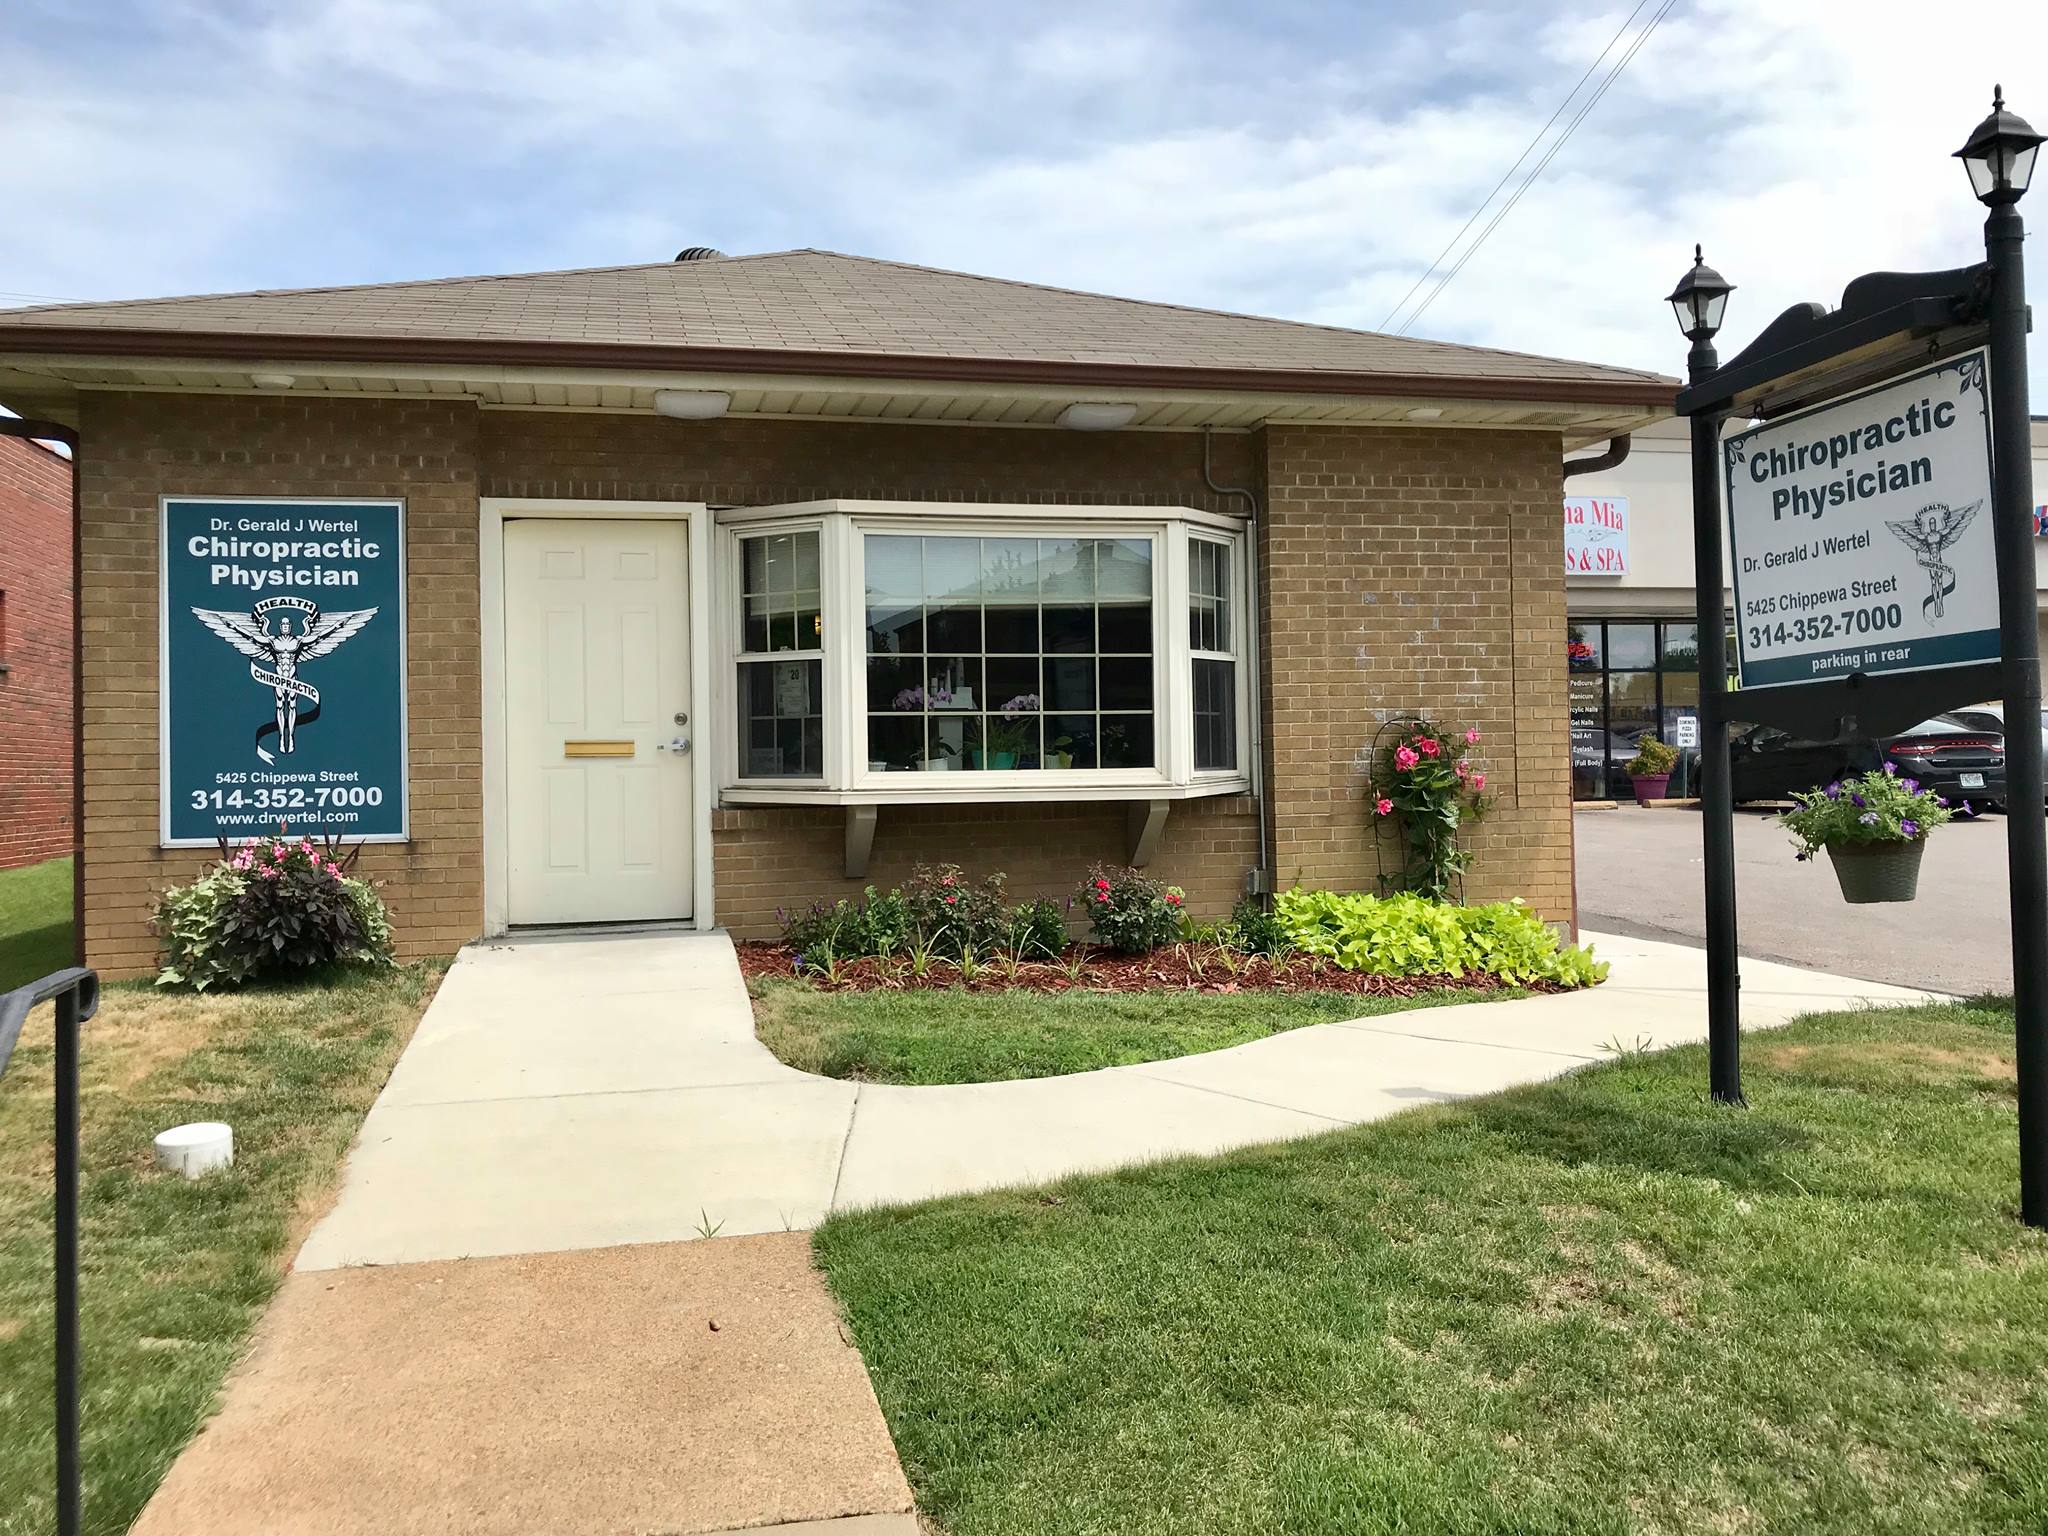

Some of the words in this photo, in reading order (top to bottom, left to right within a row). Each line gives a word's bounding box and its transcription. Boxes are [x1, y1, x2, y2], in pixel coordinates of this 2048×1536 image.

[1750, 399, 1956, 484] Chiropractic
[1772, 456, 1932, 521] Physician
[210, 518, 231, 531] Dr.
[238, 518, 290, 532] Gerald
[295, 519, 304, 532] J
[308, 519, 358, 533] Wertel
[1591, 500, 1623, 531] Mia
[188, 535, 380, 563] Chiropractic
[1580, 547, 1591, 571] &
[1597, 547, 1625, 571] SPA
[1743, 555, 1761, 573] Dr.
[1764, 545, 1807, 569] Gerald
[1811, 540, 1820, 559] J
[1823, 530, 1871, 555] Wertel
[211, 564, 360, 591] Physician
[258, 598, 314, 611] HEALTH
[1747, 598, 1776, 617] 5425
[1779, 587, 1848, 612] Chippewa
[1851, 575, 1897, 598] Street
[1749, 603, 1902, 649] 314-352-7000
[1812, 652, 1861, 673] parking
[1864, 650, 1877, 666] in
[1880, 647, 1911, 662] rear
[254, 668, 317, 699] CHIROPRACTIC
[215, 772, 247, 784] 5425
[250, 771, 316, 785] Chippewa
[320, 770, 359, 783] Street
[191, 787, 383, 810] 314-352-7000
[216, 811, 359, 825] www.drwertel.com
